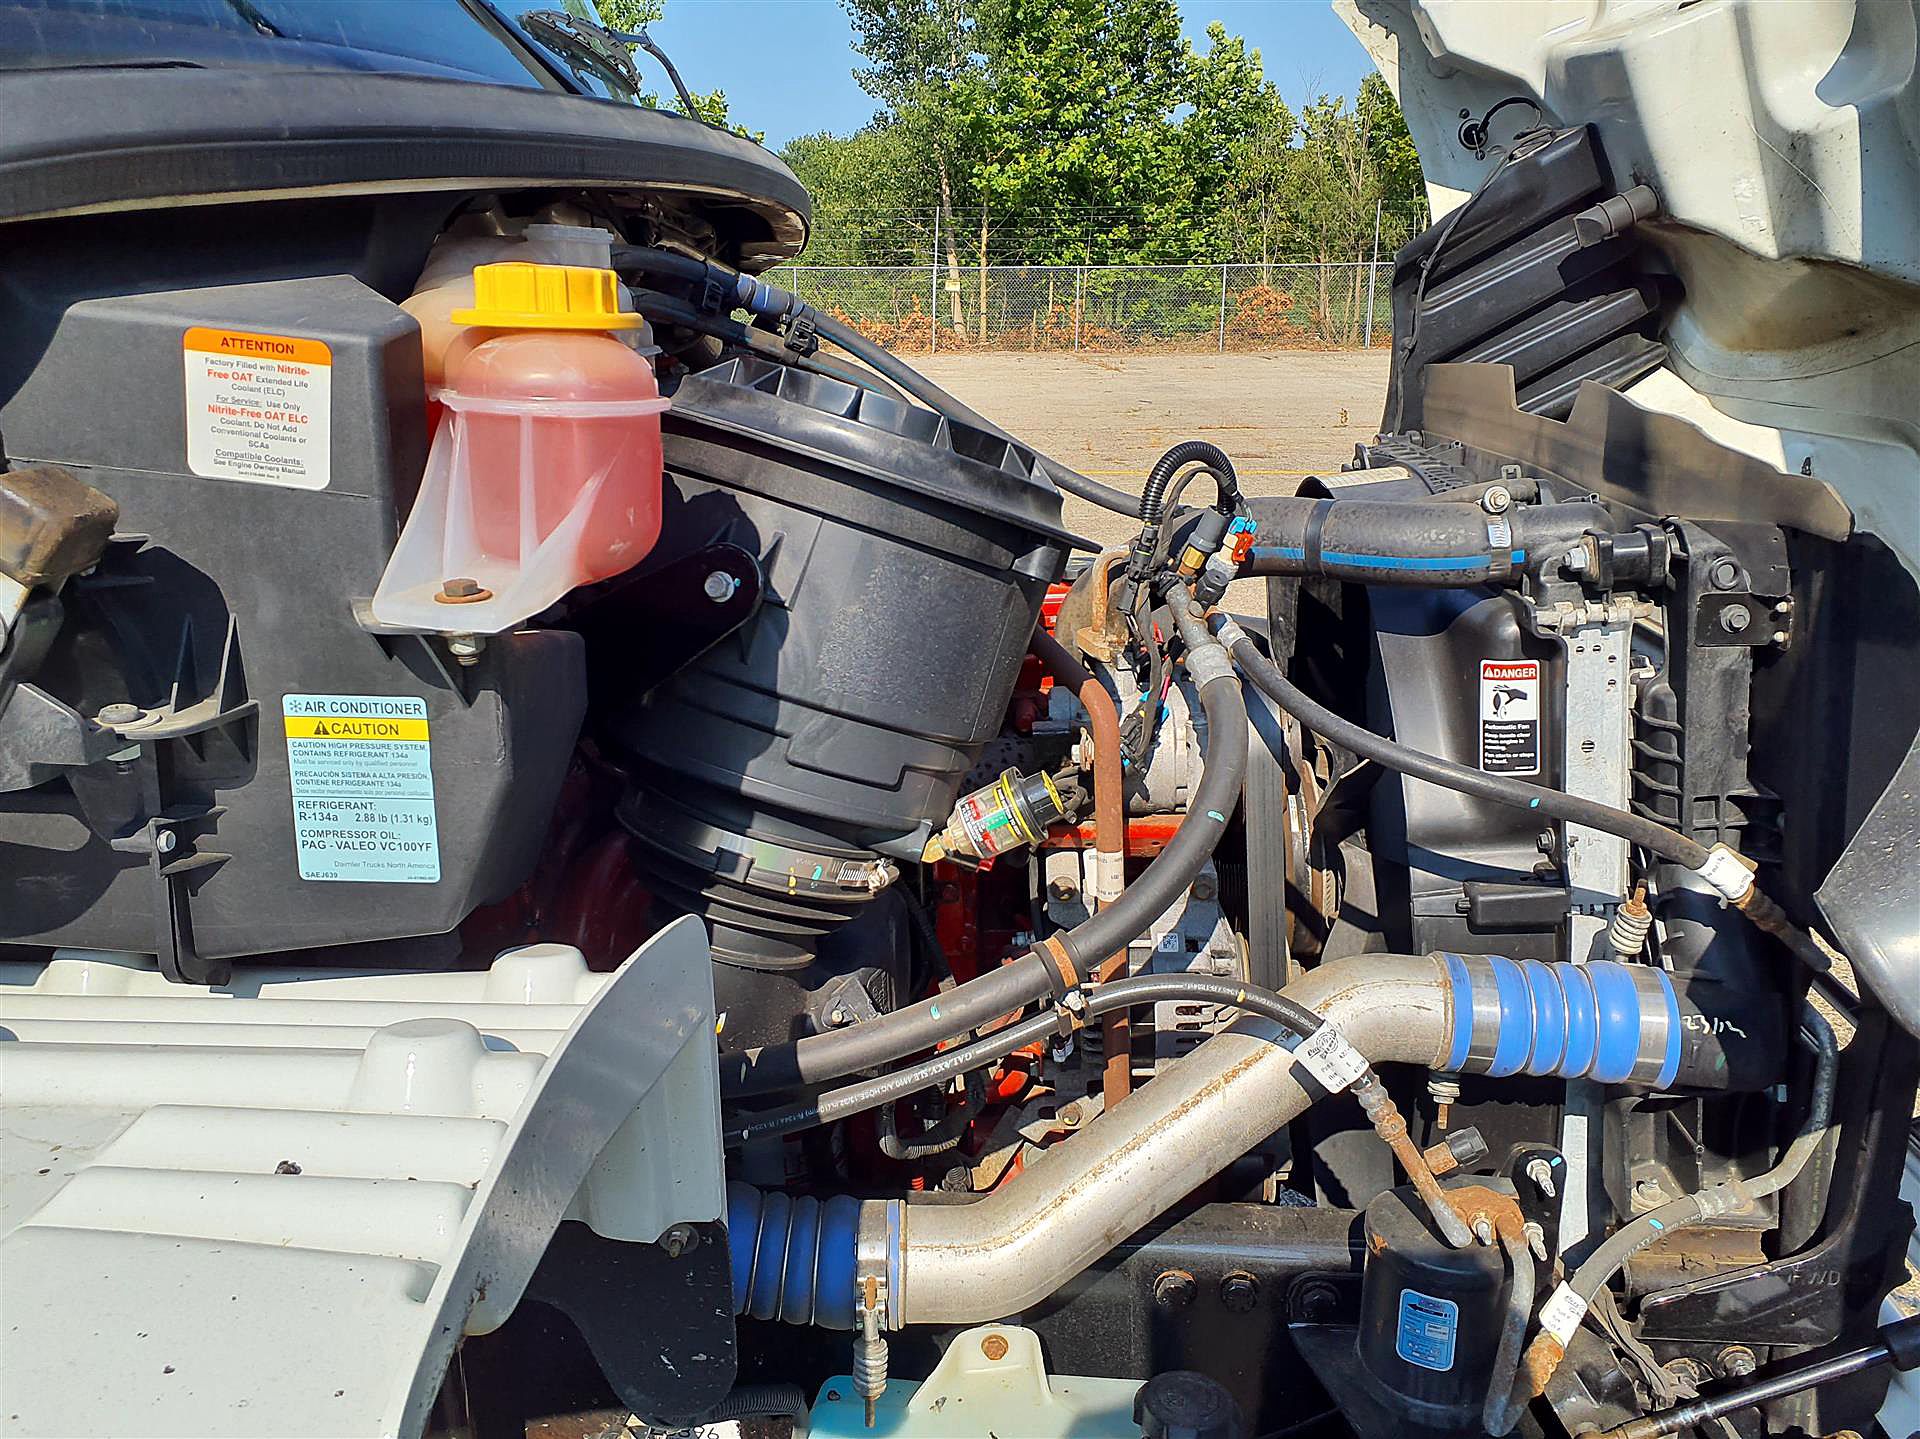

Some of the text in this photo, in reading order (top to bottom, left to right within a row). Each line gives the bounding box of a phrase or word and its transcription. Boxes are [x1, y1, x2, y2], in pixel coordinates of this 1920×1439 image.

[221, 337, 294, 354] ATTENTION
[204, 357, 234, 368] Factory
[236, 361, 257, 370] Filled
[277, 365, 310, 376] Nitrite-
[207, 369, 309, 388] Free OAT Extended Life
[232, 384, 285, 397] Coolant (ELC)
[232, 396, 261, 406] Service:
[283, 403, 301, 411] Only
[208, 405, 308, 424] Nitrite-Free OAT ELC
[220, 418, 252, 427] Coolant.
[267, 423, 280, 431] Not
[282, 425, 297, 433] Add
[211, 427, 261, 438] Conventional
[263, 432, 297, 442] Coolants
[248, 441, 270, 449] SCAs
[215, 449, 304, 466] Compatible Coolants:
[228, 460, 252, 469] Engine
[254, 463, 279, 472] Owners
[282, 466, 306, 475] Manual
[1493, 668, 1536, 678] DANGER
[304, 701, 423, 715] AIR CONDITIONER
[332, 723, 399, 735] CAUTION
[298, 801, 376, 810] REFRIGERANT:
[299, 812, 432, 825] R-134a 2.88 lb (1.31 kg)
[301, 830, 401, 839] COMPRESSOR OIL:
[302, 840, 326, 849] PAG
[336, 841, 376, 850] VALEO
[380, 843, 432, 851] VC100YF
